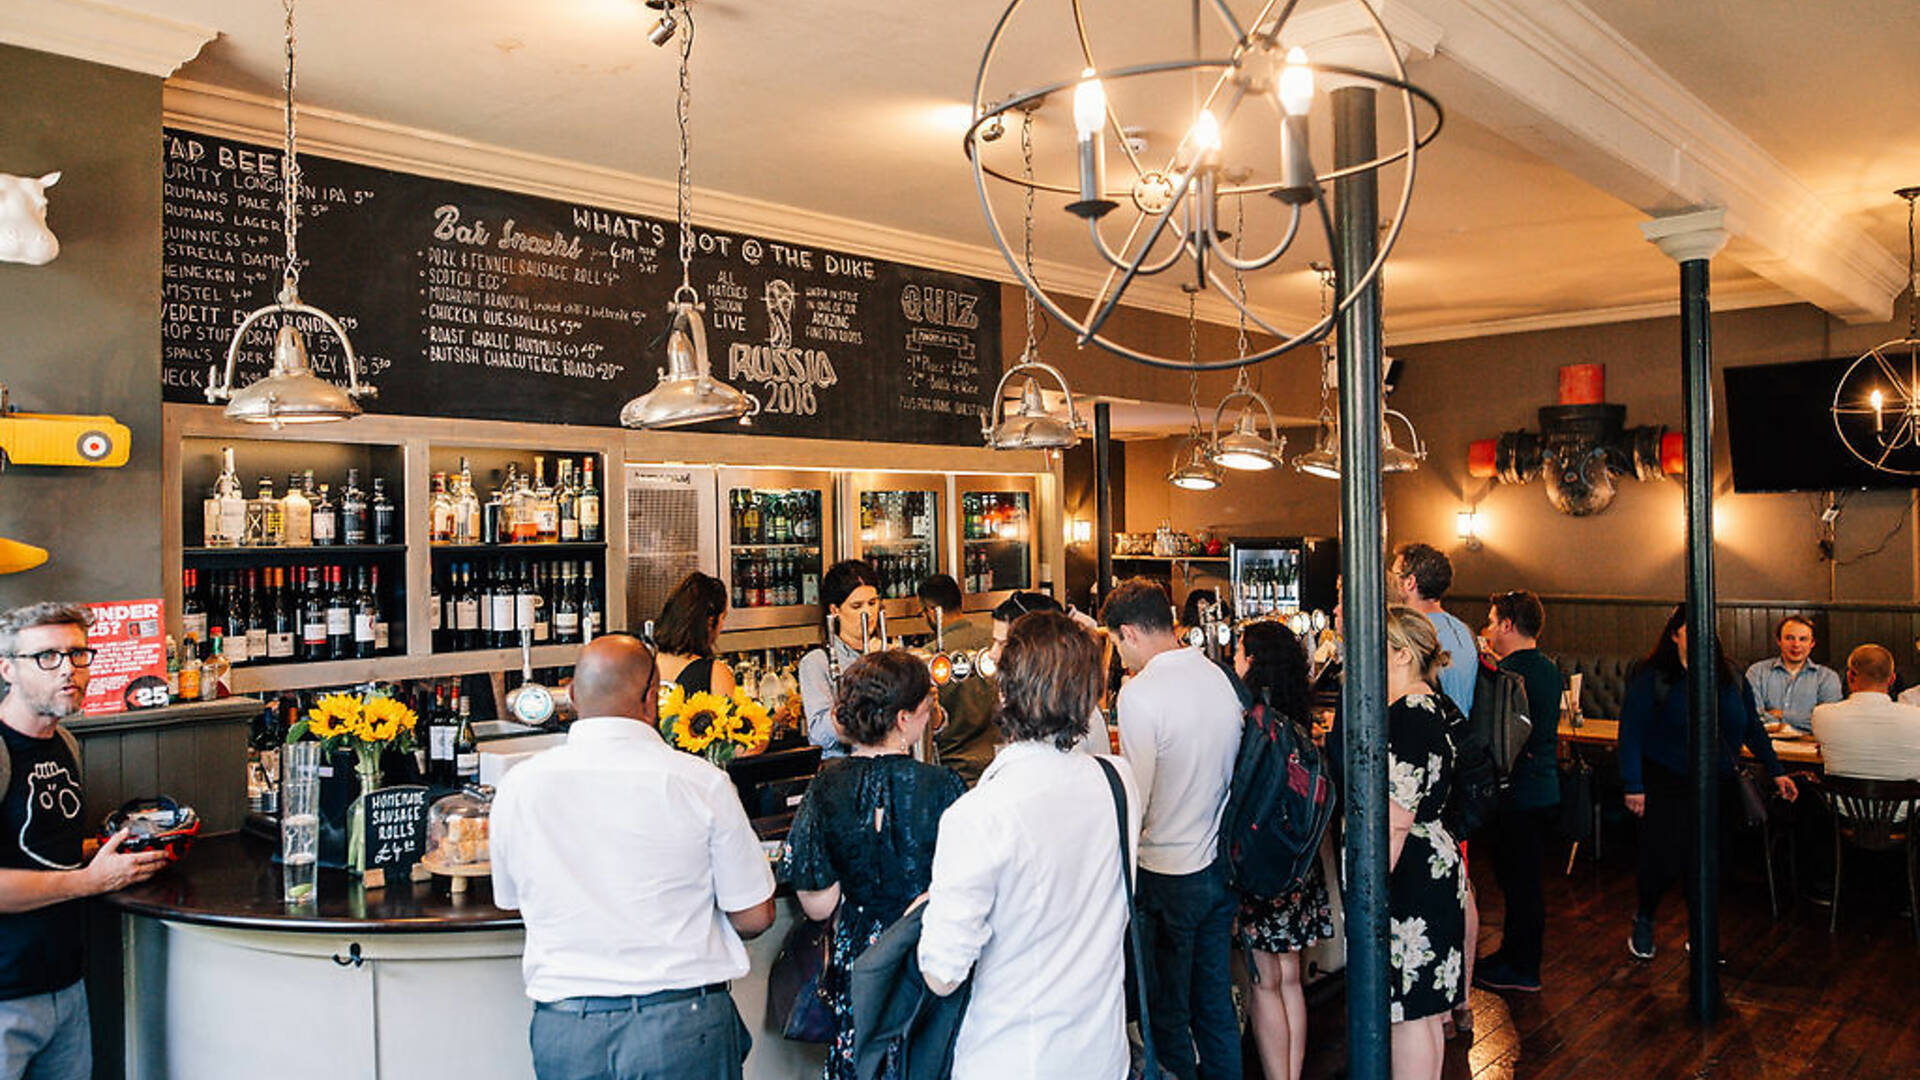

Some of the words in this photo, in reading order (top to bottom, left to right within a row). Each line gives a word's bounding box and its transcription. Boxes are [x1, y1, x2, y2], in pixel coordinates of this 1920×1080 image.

[164, 135, 206, 164] AP
[236, 195, 270, 211] PALE
[275, 200, 305, 215] AE
[322, 186, 348, 204] IPA
[233, 215, 281, 232] LAGER
[434, 203, 490, 245] Bar
[497, 218, 583, 260] Snacks
[572, 207, 666, 248] WHAT'S
[769, 244, 814, 272] THE
[825, 254, 878, 280] DUKE
[428, 247, 457, 268] PORK
[470, 253, 515, 276] FENNEL
[517, 259, 568, 281] SAUSAGE
[573, 267, 600, 286] ROLL
[428, 268, 472, 288] SCOTCH
[428, 303, 478, 324] CHICKEN
[482, 309, 558, 335] QUESADILLAS
[901, 284, 979, 330] QUIZ
[713, 312, 747, 332] LIVE
[428, 326, 466, 345] ROAST
[470, 329, 512, 350] GARLIC
[729, 342, 839, 390] RUSSIA
[764, 380, 818, 416] 2018
[371, 791, 425, 810] HOMEMADE
[371, 806, 421, 826] SAUSAGE
[378, 822, 415, 840] ROLLS
